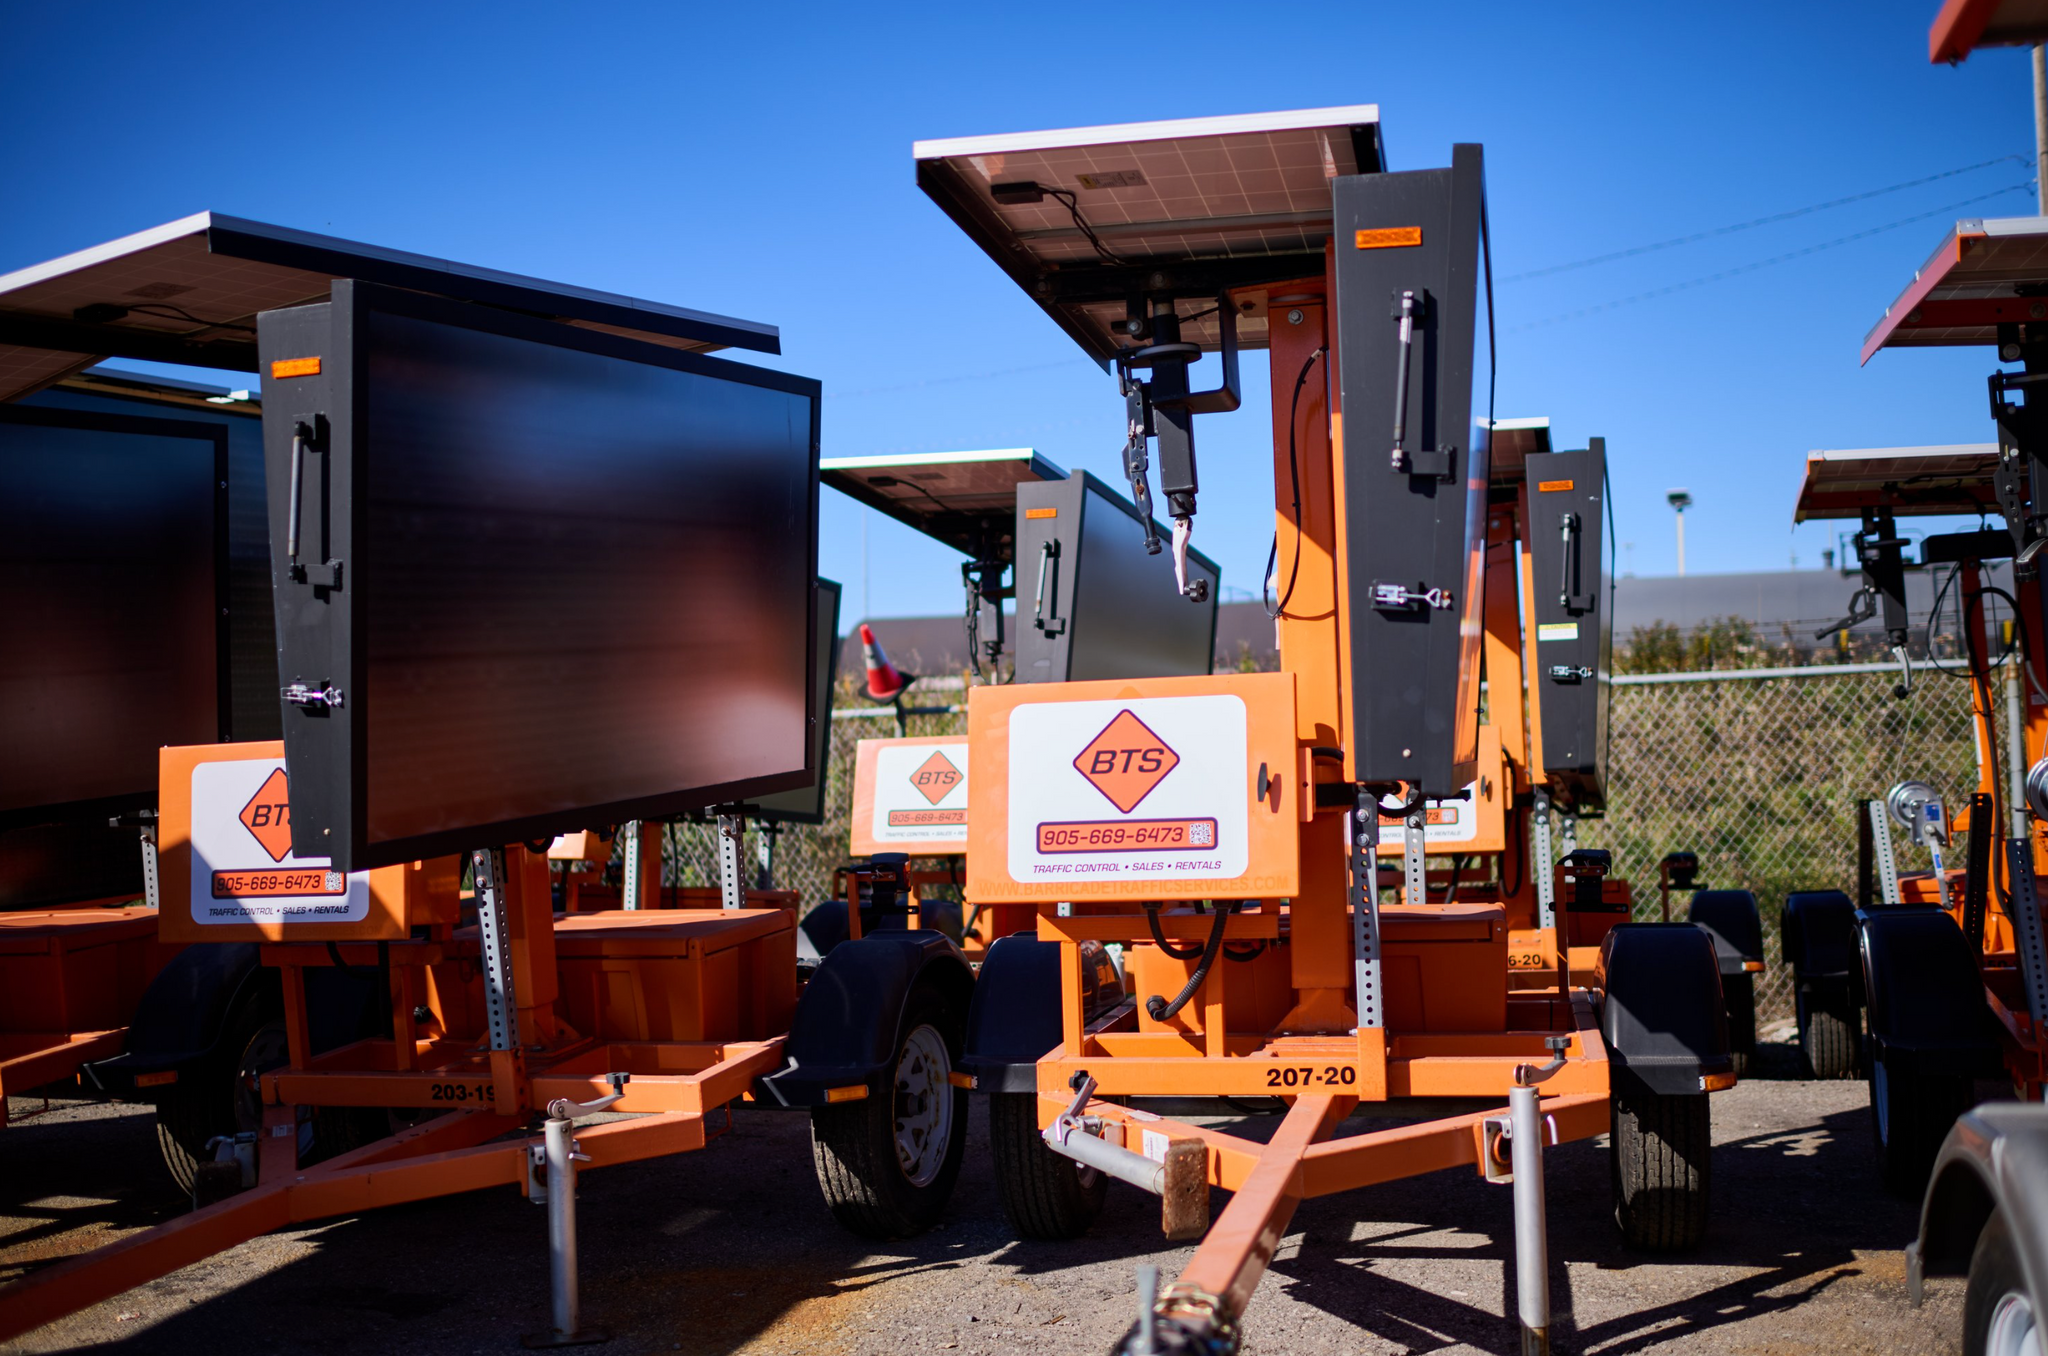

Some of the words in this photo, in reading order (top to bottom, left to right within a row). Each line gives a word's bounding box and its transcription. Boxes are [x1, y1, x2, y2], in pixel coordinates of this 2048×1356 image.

[1090, 748, 1165, 775] BTS
[917, 771, 957, 785] BTS
[251, 803, 292, 827] BT
[891, 812, 964, 823] 905-669-6473
[1043, 827, 1184, 846] 905-669-6473
[1033, 864, 1073, 874] TRAFFIC
[1075, 863, 1121, 873] CONTROL
[1132, 861, 1165, 871] SALES
[1175, 860, 1222, 870] RENTALS
[216, 874, 321, 892] 905-669-6473
[979, 876, 1289, 897] WWW.BARRICADETRAFFICSERVICES.COM
[209, 908, 238, 916] TRAFFIC
[239, 907, 274, 916] CONTROL
[282, 906, 306, 915] SALES
[314, 905, 350, 914] RENTALS
[1266, 1066, 1356, 1087] 207-20
[431, 1084, 495, 1101] 203-19
